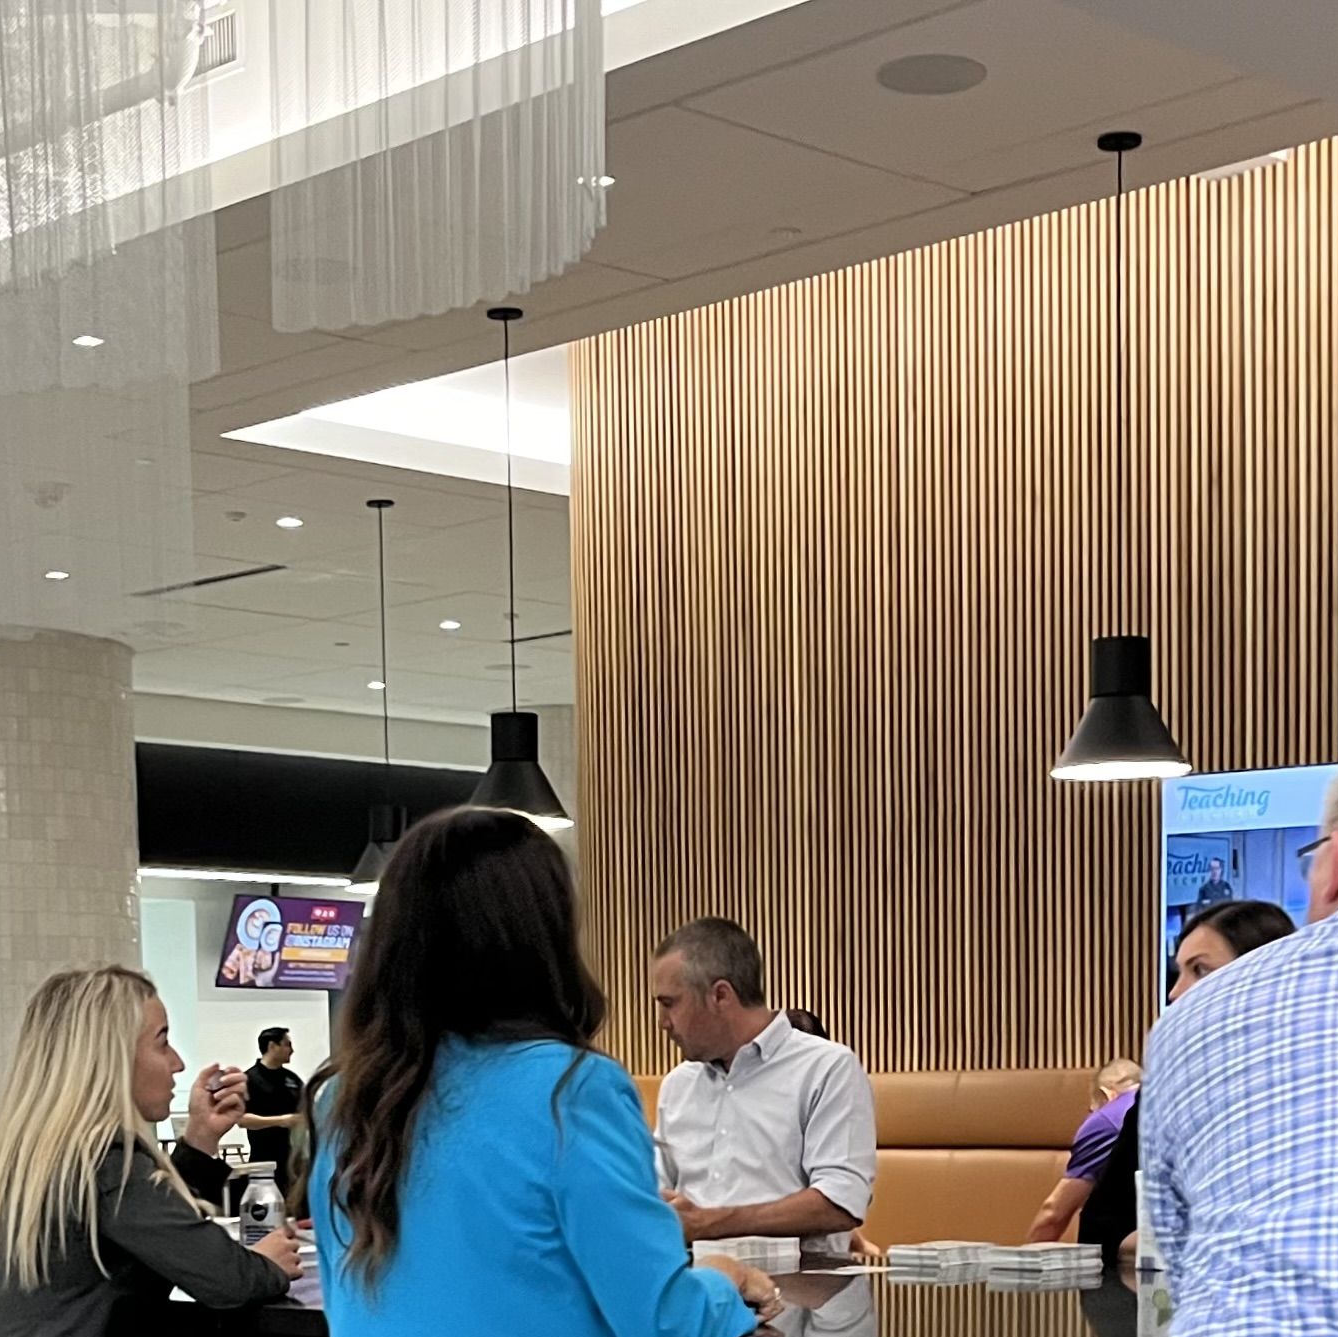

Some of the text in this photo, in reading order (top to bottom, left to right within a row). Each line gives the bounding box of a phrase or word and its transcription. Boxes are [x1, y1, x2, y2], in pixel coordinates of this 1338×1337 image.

[1177, 784, 1271, 816] Teaching
[287, 923, 326, 935] FOLLOW
[327, 924, 341, 936] US
